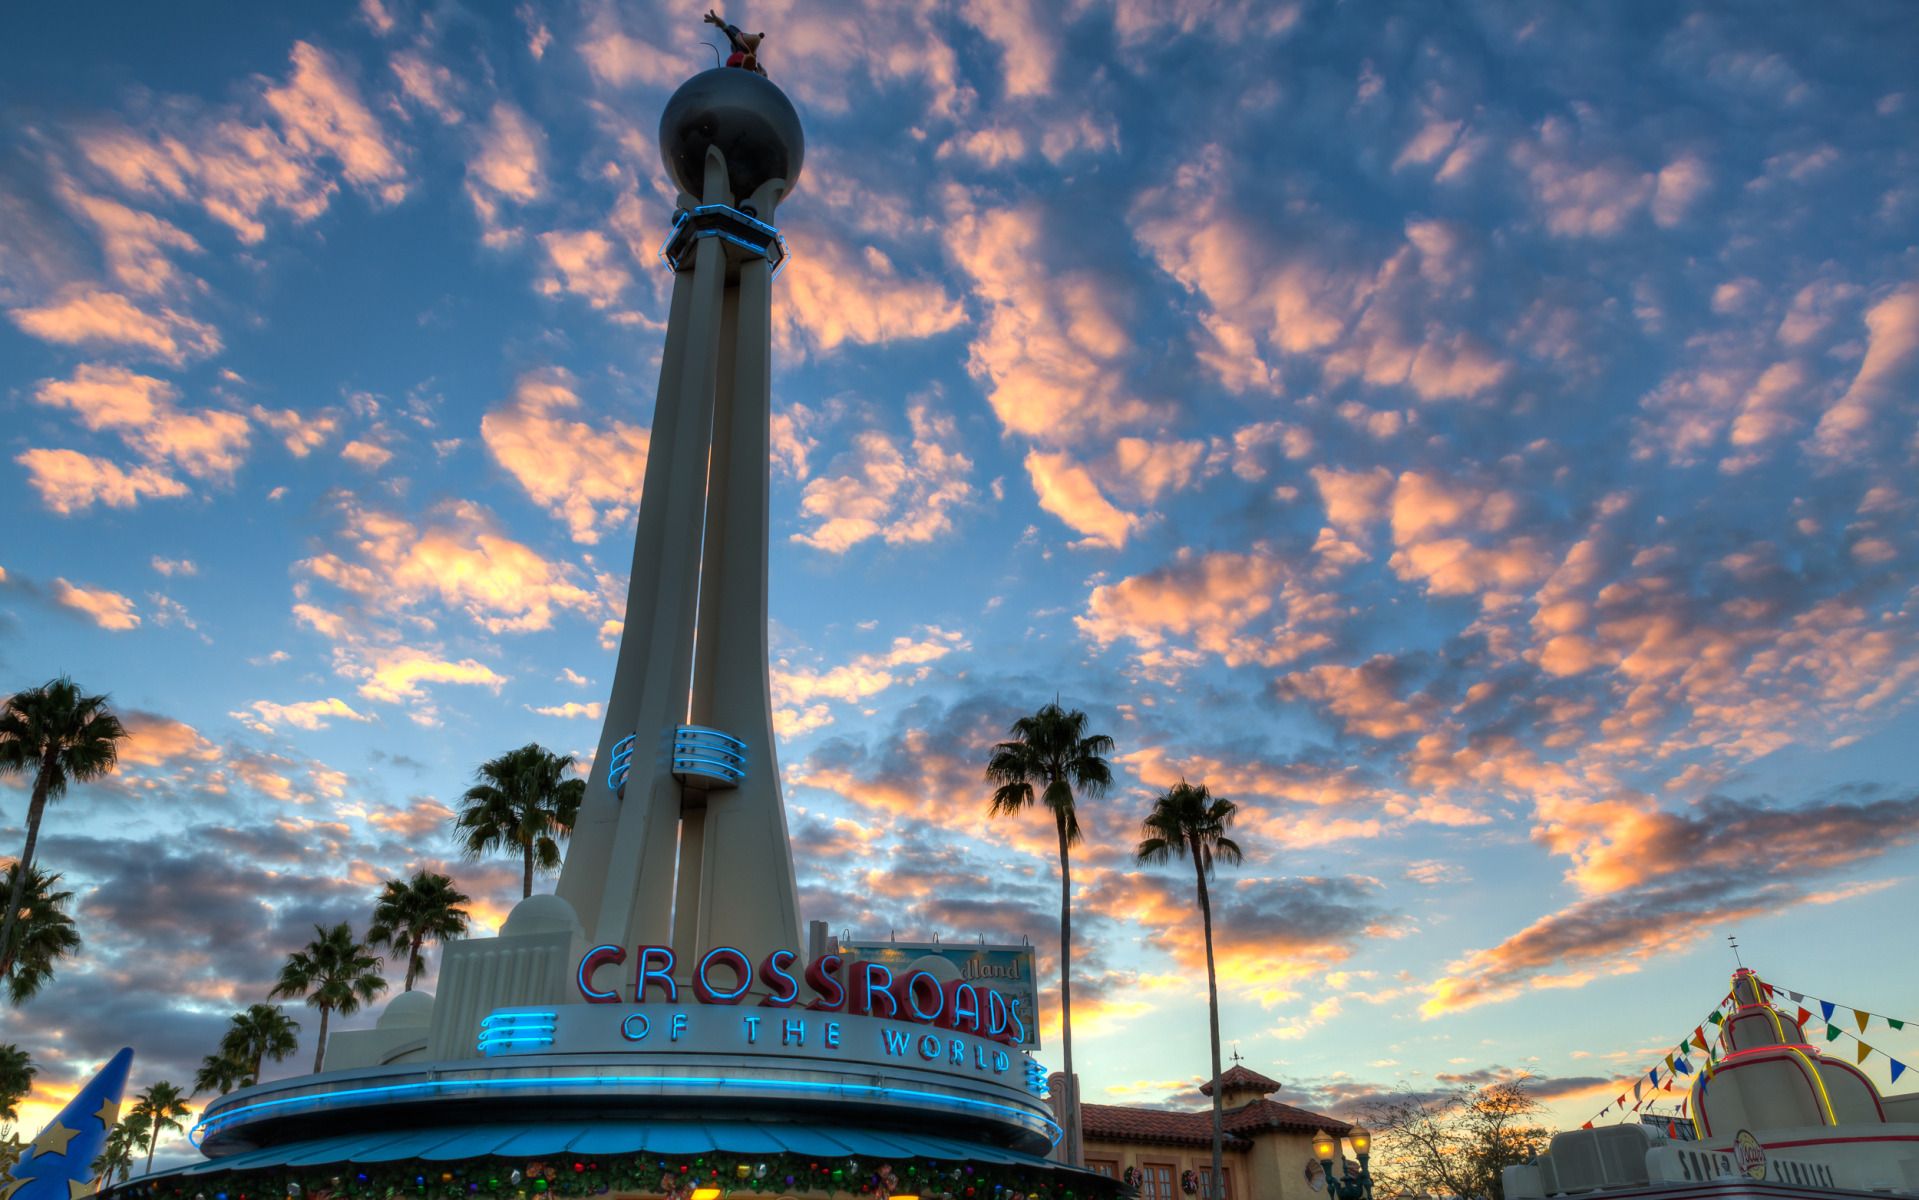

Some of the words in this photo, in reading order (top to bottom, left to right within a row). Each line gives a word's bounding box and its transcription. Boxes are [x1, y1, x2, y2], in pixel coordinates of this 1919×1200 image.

[576, 944, 1025, 1048] CROSSROADS
[621, 1013, 688, 1041] OF
[744, 1015, 841, 1048] THE
[881, 1029, 1010, 1072] WORLD
[1678, 1150, 1732, 1181] SUPER
[1773, 1160, 1834, 1188] SERVICE
